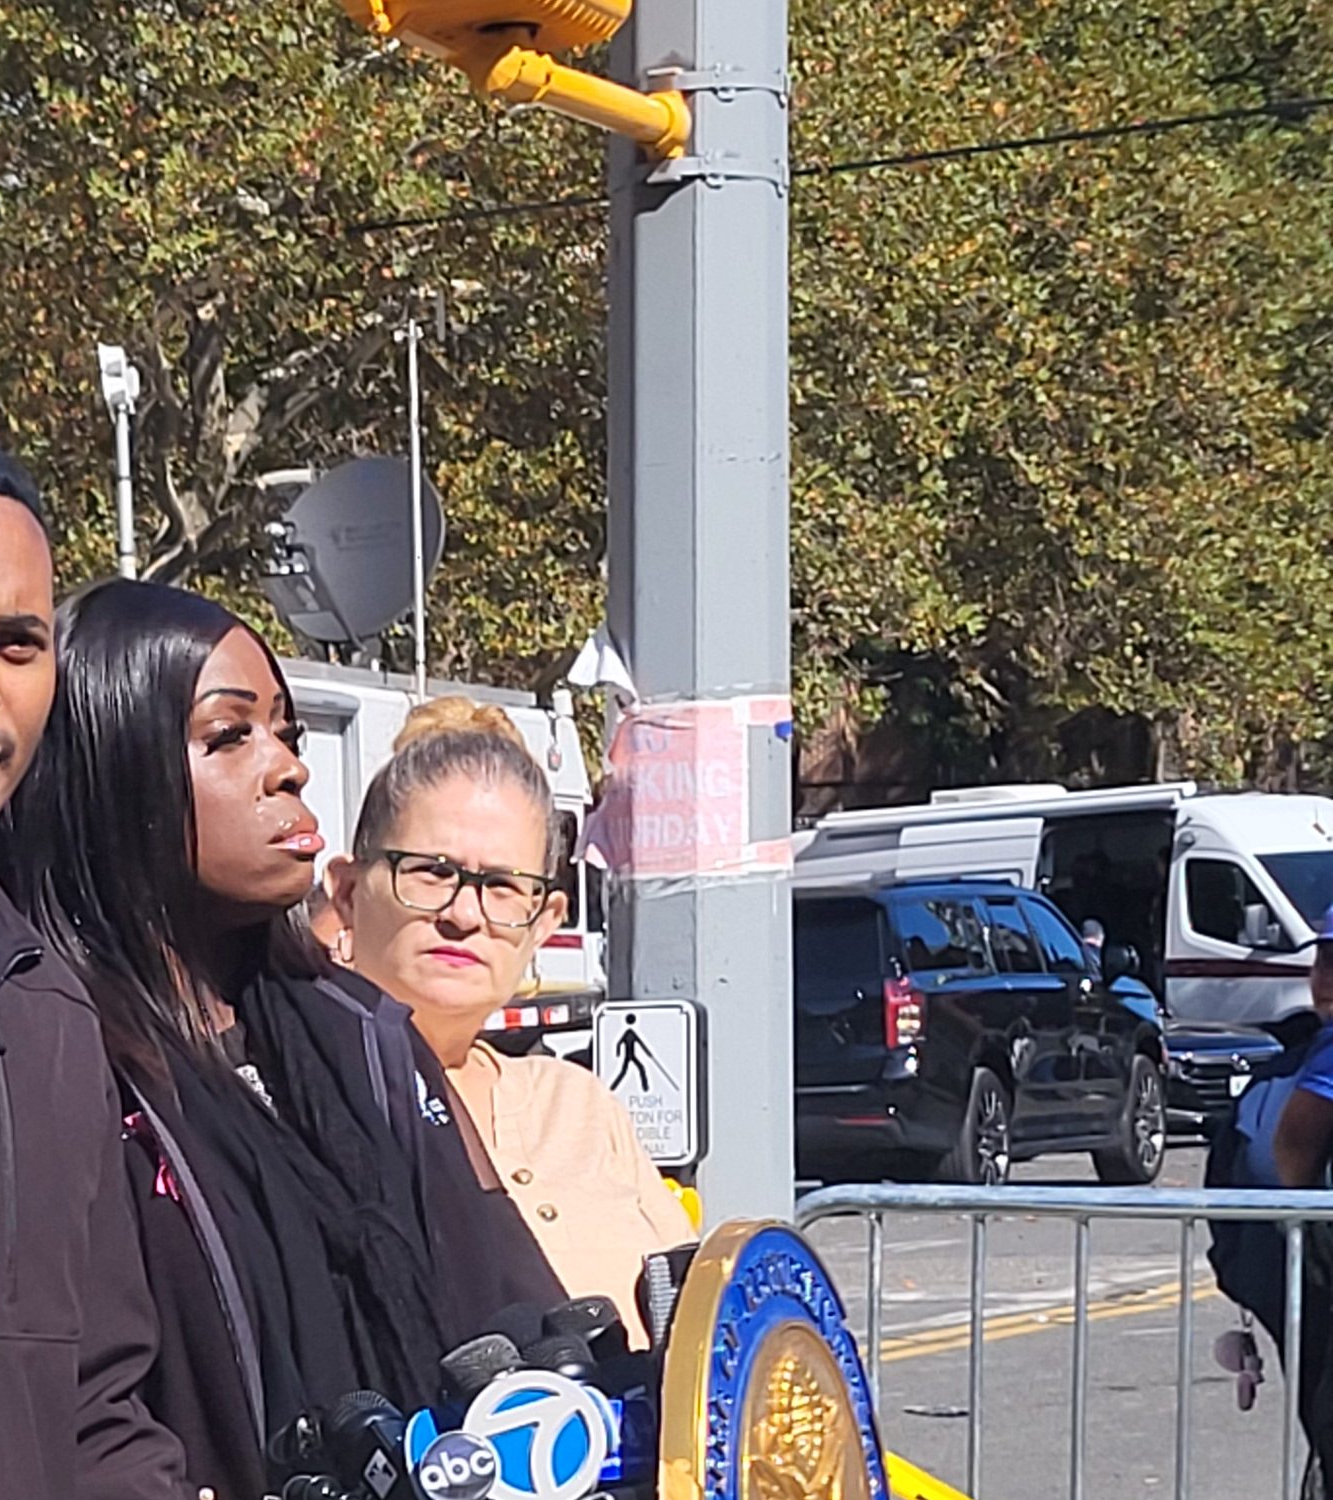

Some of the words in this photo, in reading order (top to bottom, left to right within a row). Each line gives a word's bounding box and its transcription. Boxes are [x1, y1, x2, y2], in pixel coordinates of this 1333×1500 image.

[635, 758, 731, 801] KING
[624, 810, 732, 848] URDAY
[629, 1095, 664, 1108] PUSH
[629, 1109, 655, 1124] TON
[657, 1109, 683, 1124] FOR
[635, 1126, 672, 1140] DIBLE
[420, 1449, 494, 1491] abc
